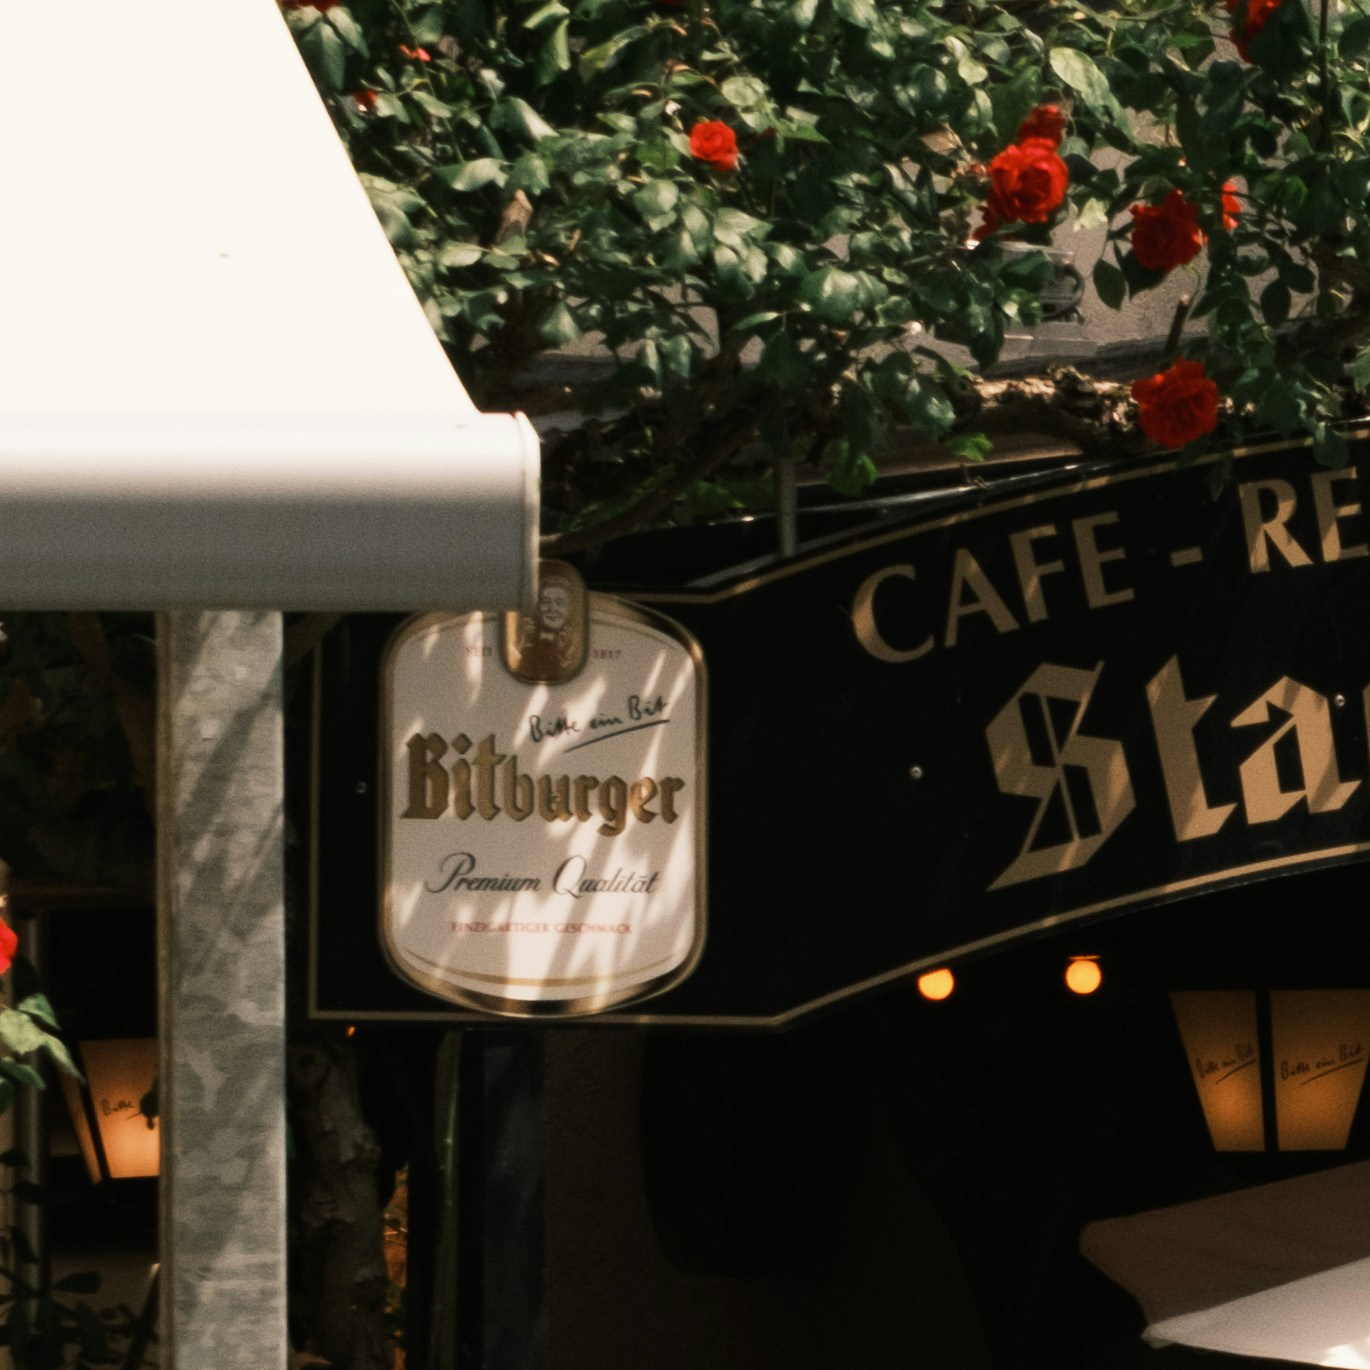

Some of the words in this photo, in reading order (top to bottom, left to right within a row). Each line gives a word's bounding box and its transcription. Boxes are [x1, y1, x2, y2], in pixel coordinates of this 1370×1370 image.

[849, 509, 1135, 665] CAFE
[529, 715, 580, 743] Bitte
[590, 713, 623, 730] ein
[627, 695, 668, 721] Bit
[401, 732, 685, 838] Bitburger
[426, 852, 541, 894] Premium
[552, 855, 659, 899] Qualität
